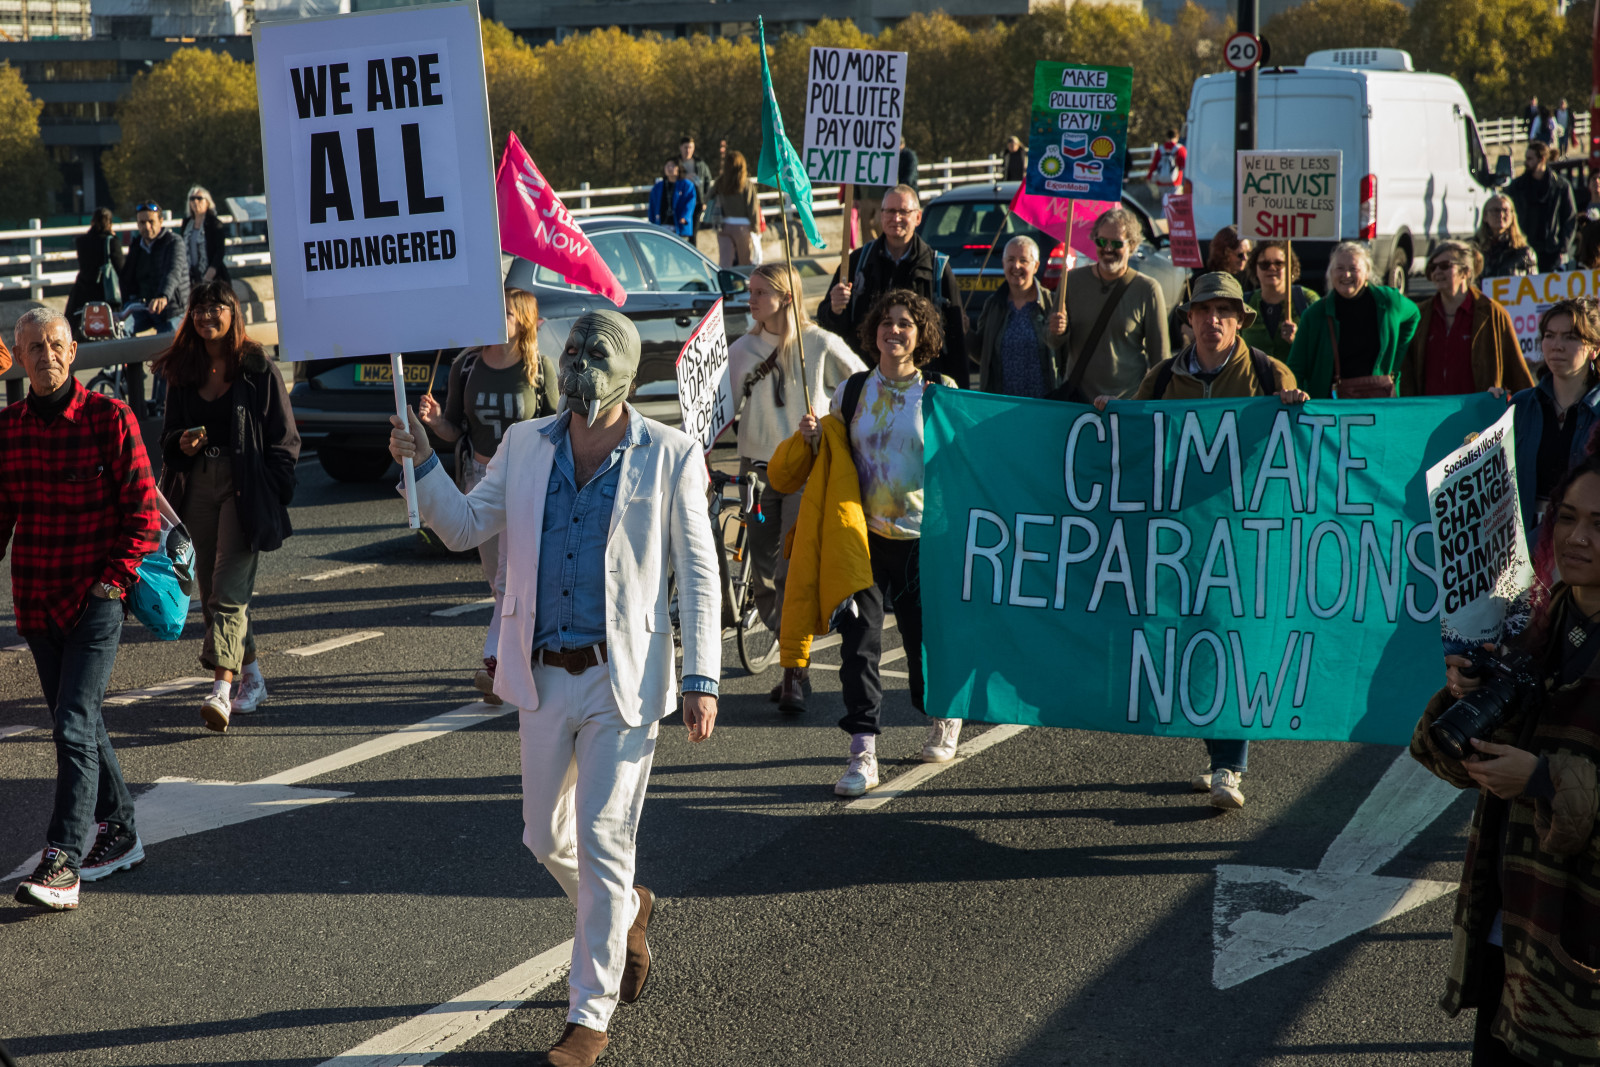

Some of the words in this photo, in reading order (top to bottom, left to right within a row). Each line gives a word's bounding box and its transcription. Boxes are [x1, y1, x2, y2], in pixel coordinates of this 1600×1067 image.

[812, 49, 840, 81] NO
[842, 51, 898, 83] MORE
[1230, 44, 1256, 60] 20
[290, 62, 353, 119] WE
[367, 53, 443, 112] ARE
[810, 82, 900, 118] POLLUTER
[1050, 91, 1117, 110] POLLUTERS
[1062, 69, 1106, 87] MAKE
[310, 123, 445, 224] ALL
[806, 147, 851, 181] EXIT
[855, 150, 895, 185] ECT
[1243, 172, 1336, 197] ACTIVIST
[1280, 157, 1295, 170] BE
[1301, 157, 1330, 171] LESS
[1248, 196, 1259, 208] IF
[1297, 199, 1308, 210] BE
[1311, 199, 1334, 212] LESS
[1255, 210, 1317, 238] SHIT
[303, 229, 457, 272] ENDANGERED
[689, 332, 728, 404] DAMAGE
[689, 384, 727, 440] LOBAL
[698, 405, 726, 450] UTH
[1064, 409, 1376, 515] CLIMATE
[1435, 446, 1509, 518] SYSTEM
[1438, 470, 1510, 541] CHANGE
[961, 507, 1438, 623] REPARATIONS
[1440, 522, 1481, 568] NOT
[1442, 516, 1517, 590] CLIMATE
[1444, 541, 1517, 614] CHANGE
[1127, 627, 1314, 730] NOW!
